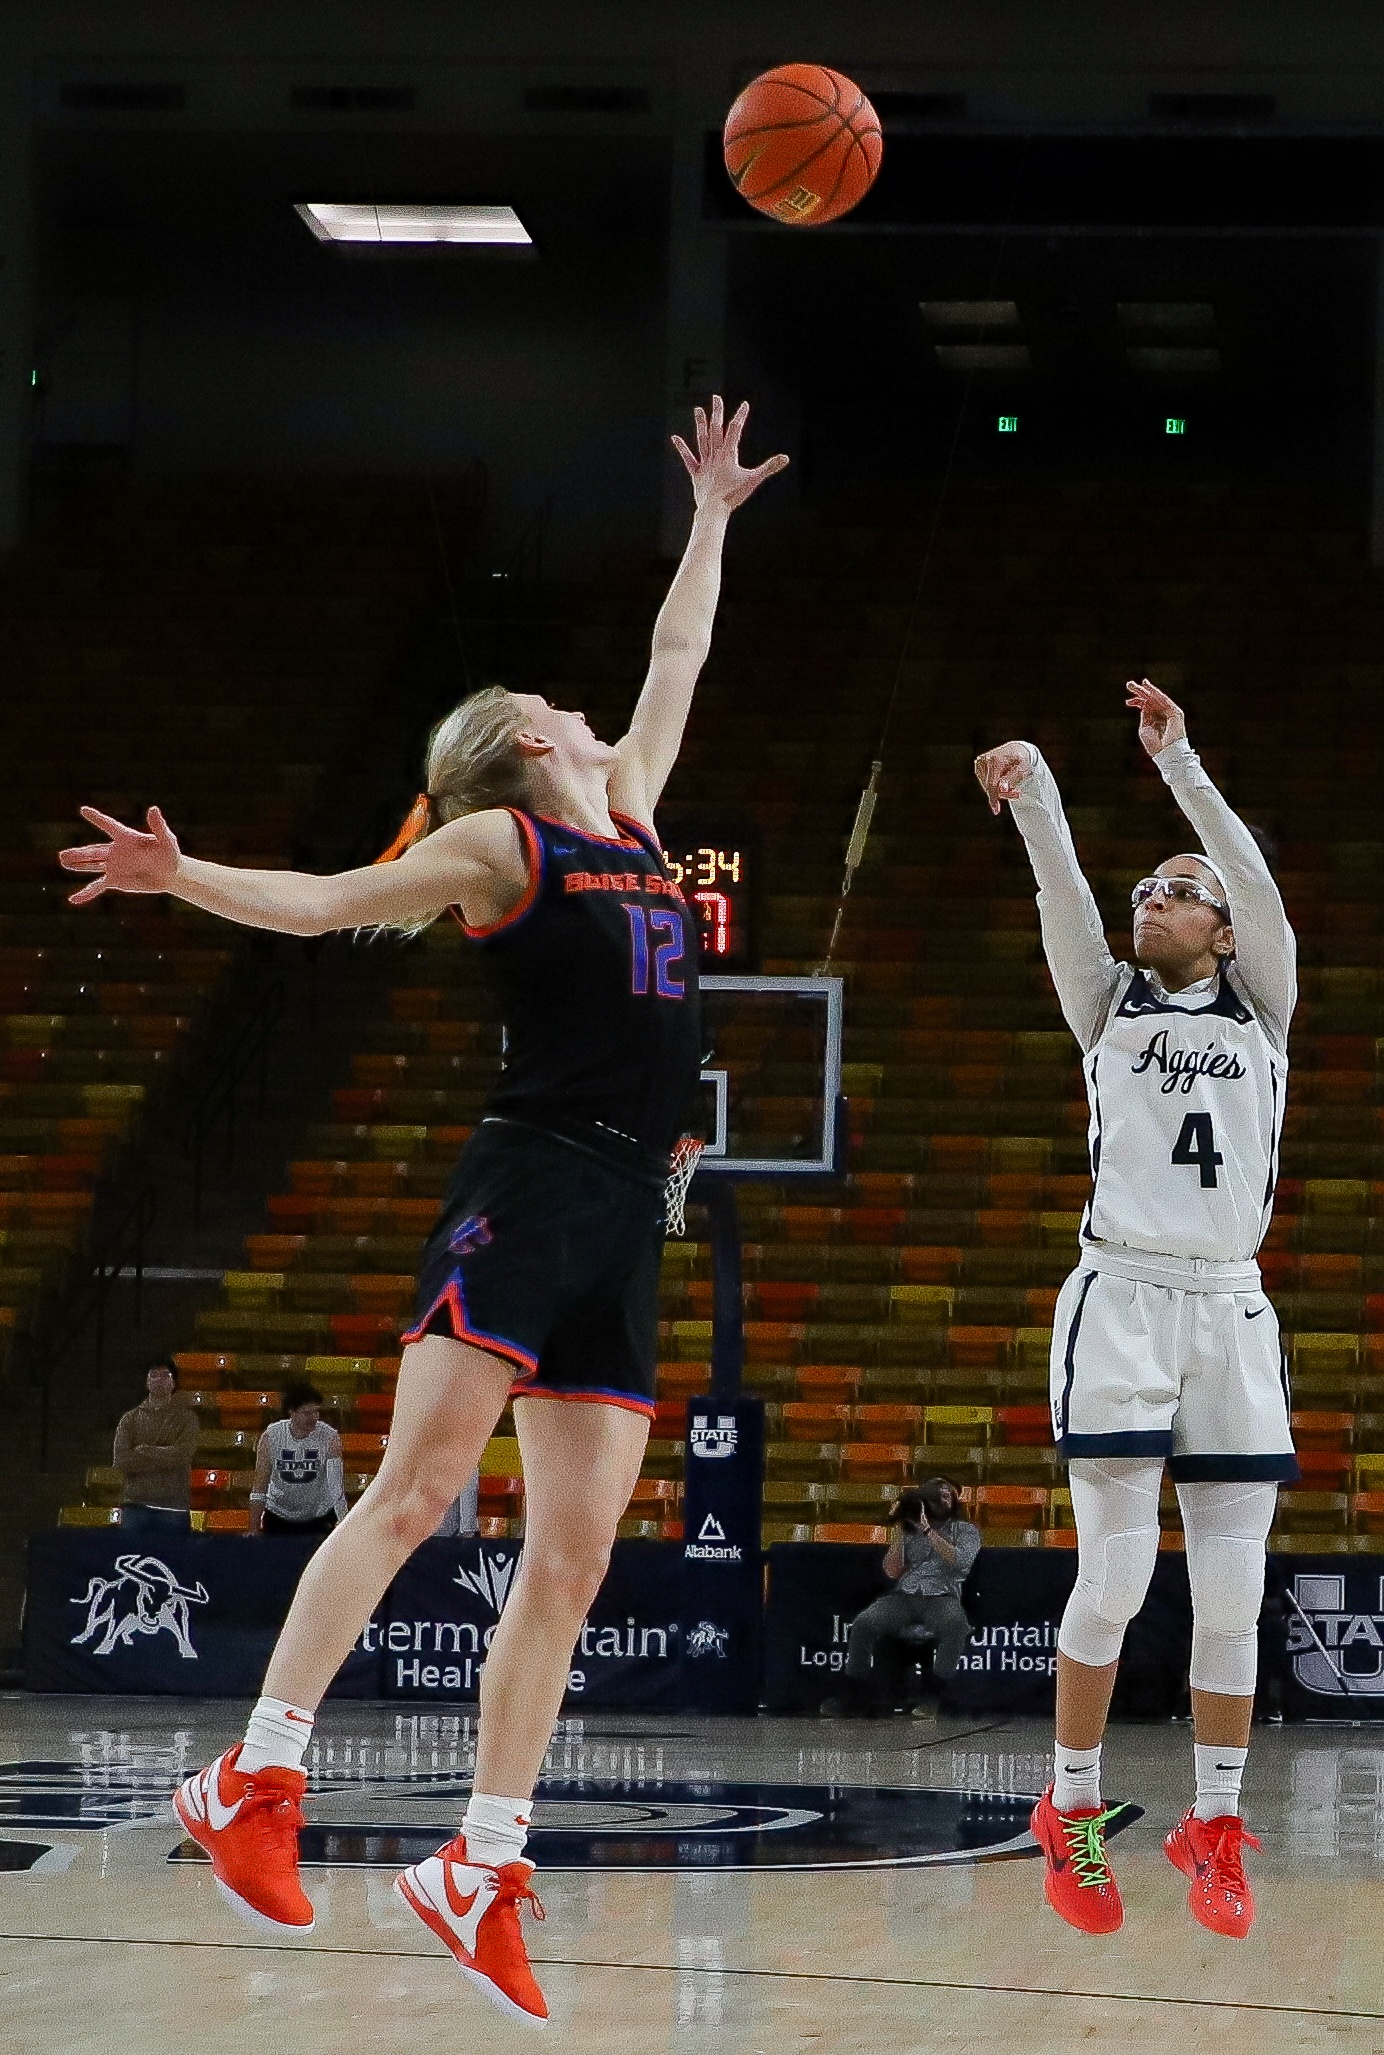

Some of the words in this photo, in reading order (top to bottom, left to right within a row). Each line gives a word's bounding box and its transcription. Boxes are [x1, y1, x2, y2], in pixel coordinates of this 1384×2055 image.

[620, 903, 685, 999] 12
[1131, 1029, 1247, 1095] Aggies
[1170, 1111, 1224, 1190] 4
[690, 1429, 739, 1444] STATE
[684, 1544, 742, 1560] Altabank
[1286, 1613, 1384, 1651] STA
[800, 1645, 874, 1672] Log
[1001, 1650, 1058, 1677] Hosp
